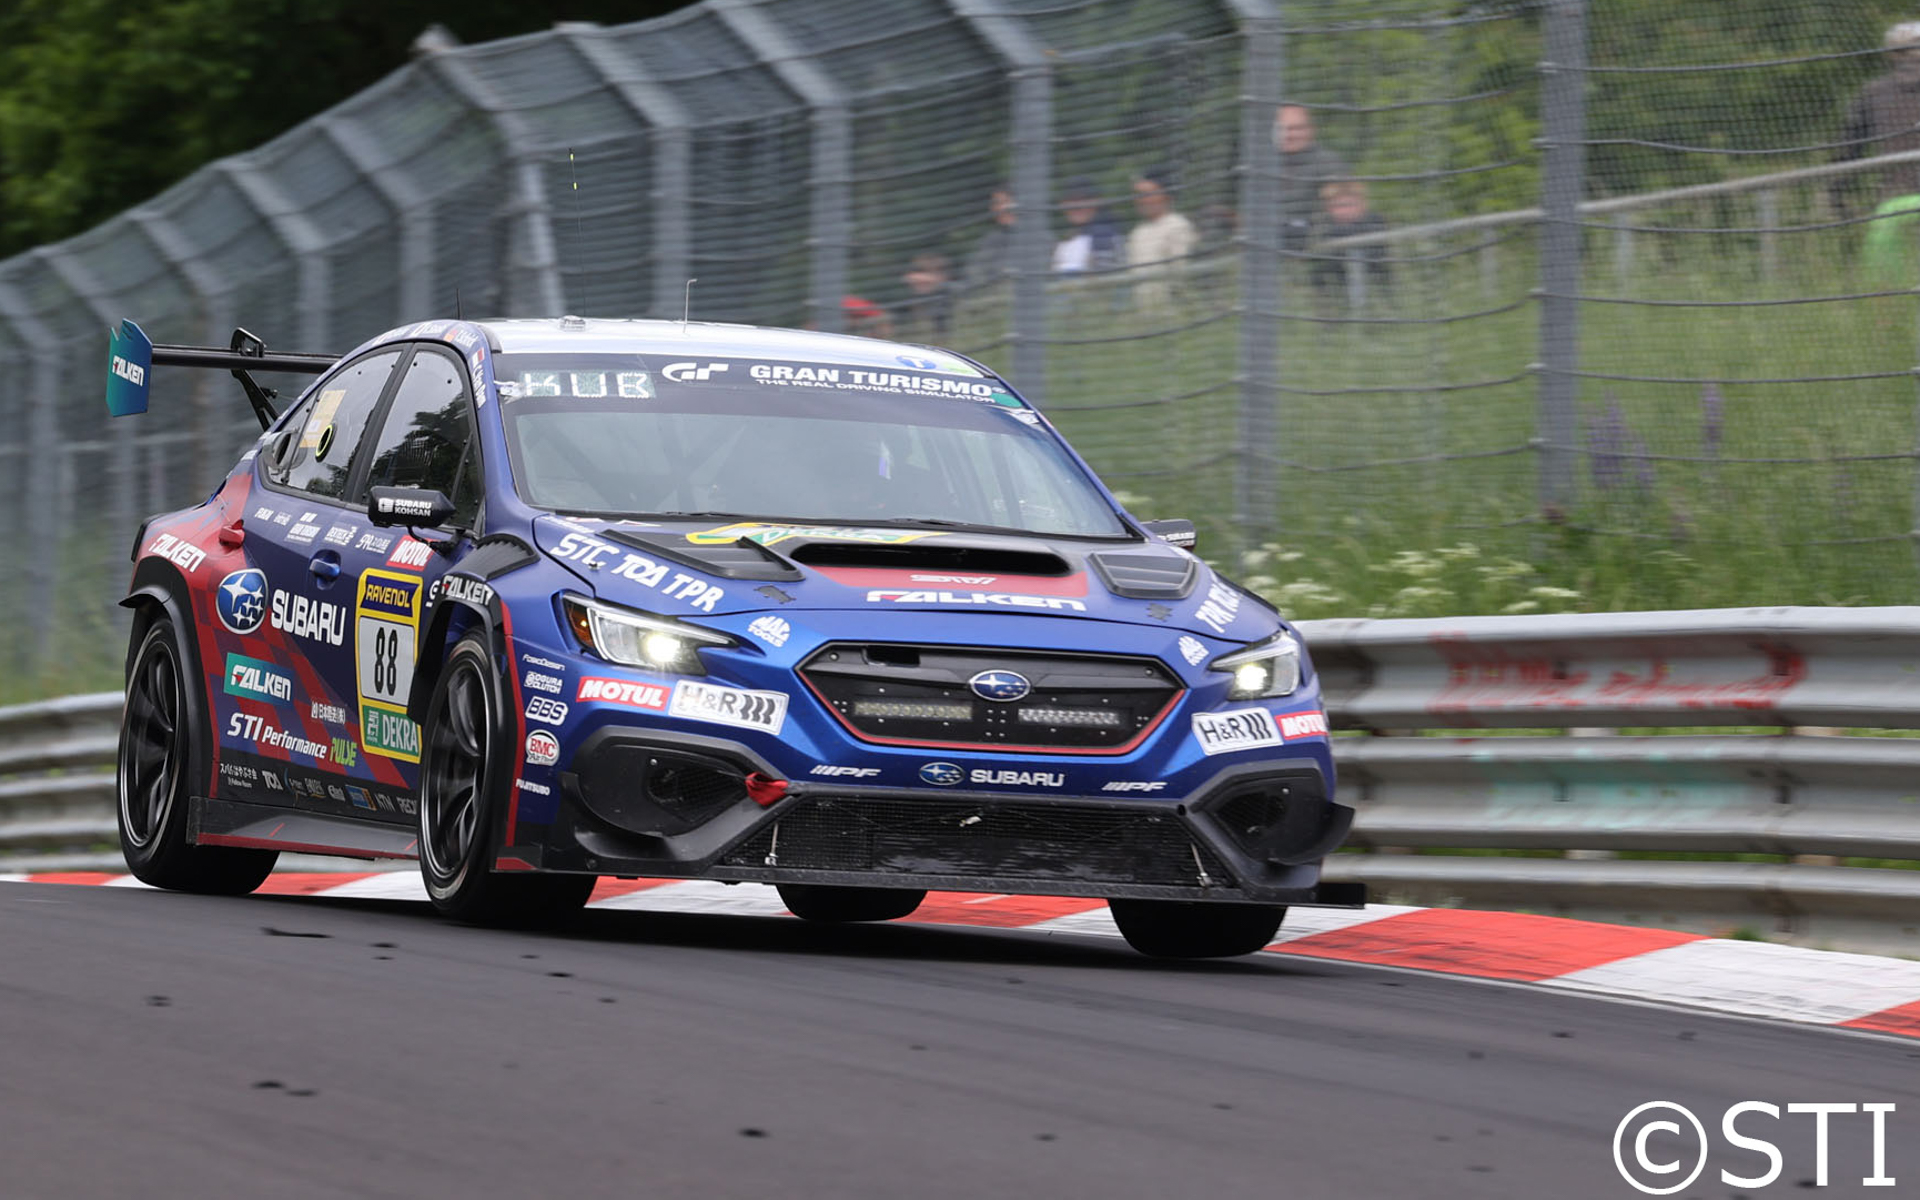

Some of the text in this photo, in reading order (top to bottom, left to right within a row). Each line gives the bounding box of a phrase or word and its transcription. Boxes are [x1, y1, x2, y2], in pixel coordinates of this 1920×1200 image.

[112, 355, 145, 387] FALKEN
[750, 364, 839, 382] GRAN
[524, 372, 650, 399] KUB
[755, 378, 996, 404] THE REAL DRIVING SIMULATOR
[394, 498, 433, 509] SUBARU
[394, 506, 431, 517] KOHSAN
[148, 533, 208, 573] FALKEN
[390, 539, 432, 567] MOTUL
[551, 533, 725, 613] STC TOA TPR
[366, 584, 412, 609] RAVENOL
[441, 575, 494, 606] FALKEN
[866, 590, 1087, 612] FALKEN
[271, 589, 348, 646] SUBARU
[749, 616, 790, 642] MAC
[374, 626, 399, 696] 88
[230, 664, 292, 702] FALKEN
[579, 680, 665, 708] MOTUL
[526, 697, 567, 723] BBS
[227, 712, 264, 741] STI
[262, 725, 328, 760] Performance
[382, 714, 419, 753] DEKRA
[1199, 717, 1247, 743] H&R
[329, 737, 358, 767] PULSE
[529, 737, 557, 758] BMC
[970, 769, 1065, 787] SUBARU
